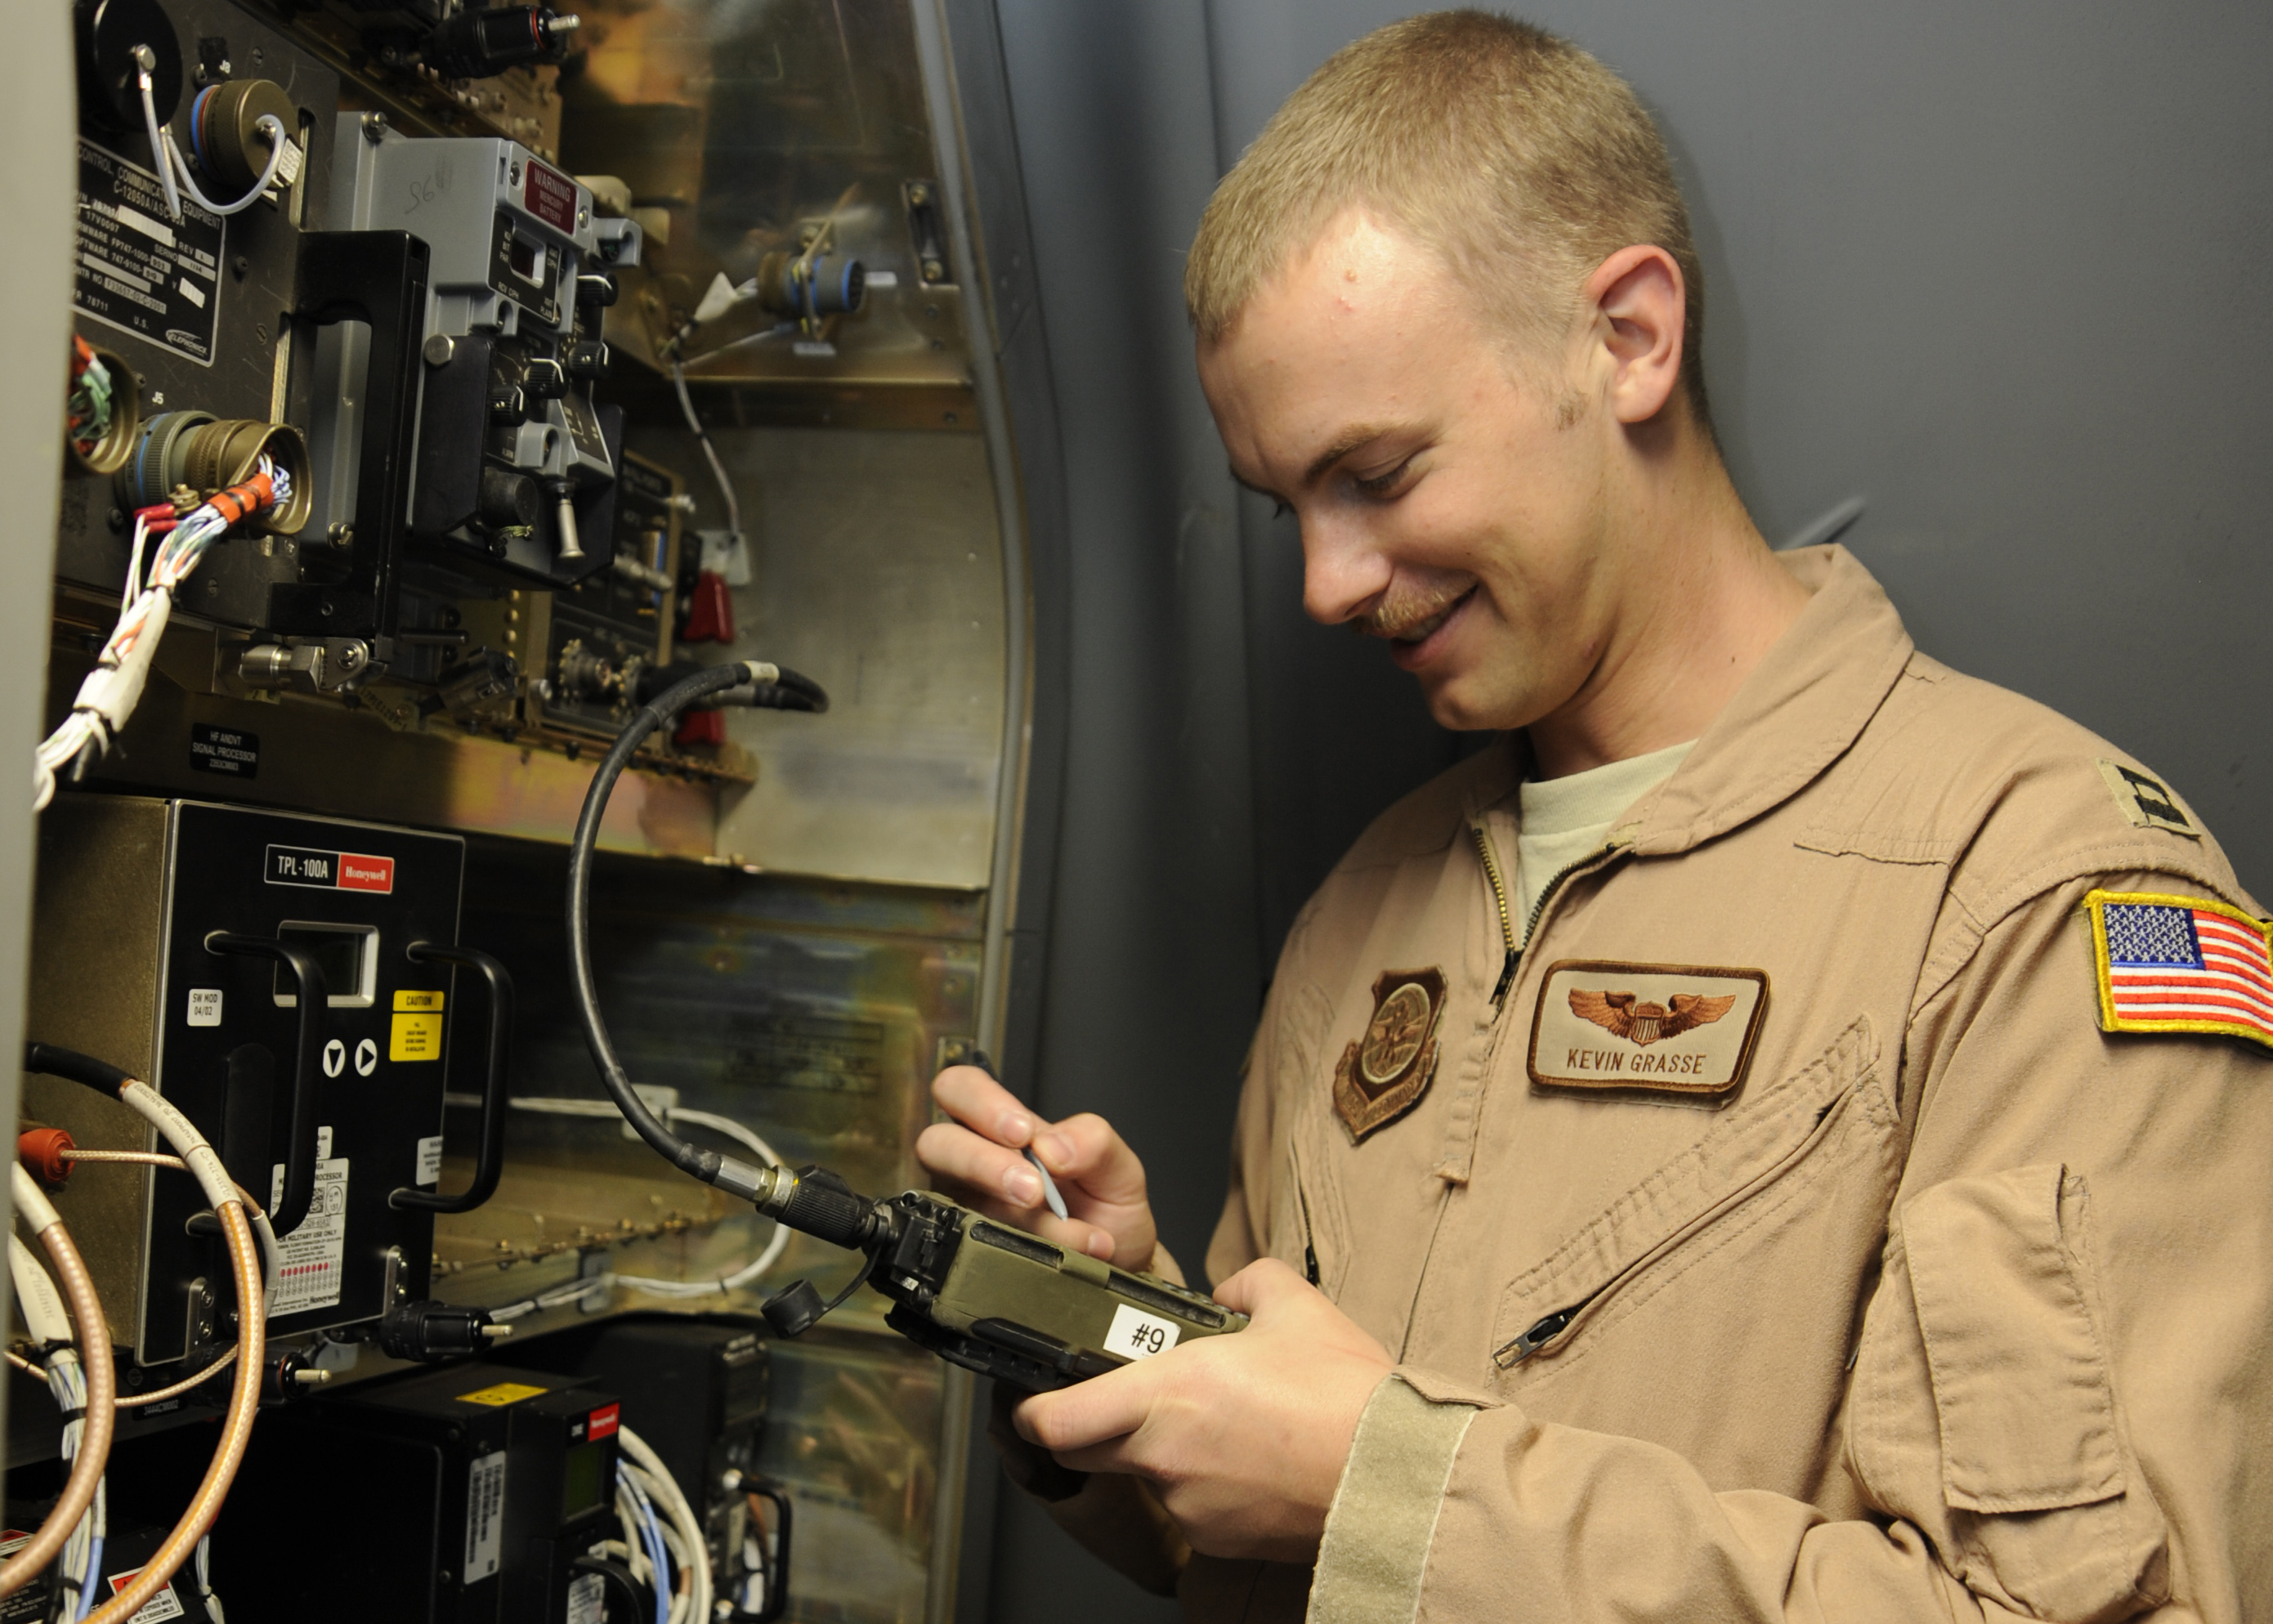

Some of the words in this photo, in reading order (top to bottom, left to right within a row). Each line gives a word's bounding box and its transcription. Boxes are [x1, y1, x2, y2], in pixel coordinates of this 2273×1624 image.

[534, 167, 571, 203] WARNING
[539, 190, 564, 212] MERCURY
[182, 200, 221, 230] EQUIPMENT
[539, 203, 562, 224] BATTERY
[178, 241, 195, 256] REV
[153, 391, 163, 405] J5
[209, 730, 221, 742] HF
[220, 731, 243, 746] ANDVT
[192, 742, 217, 756] SIGNAL
[217, 746, 257, 763] PROCESSOR
[278, 855, 329, 879] TPL-100A
[345, 866, 387, 883] Honeywell
[192, 993, 203, 1003] SW
[204, 993, 218, 1004] MOD
[406, 995, 432, 1007] CAUTION
[1567, 1049, 1625, 1072] KEVIN
[1631, 1054, 1707, 1074] GRASSE
[288, 1232, 312, 1242] MILITARY
[313, 1230, 324, 1238] USE
[309, 1291, 339, 1304] Honeywell
[1131, 1322, 1165, 1353] #9
